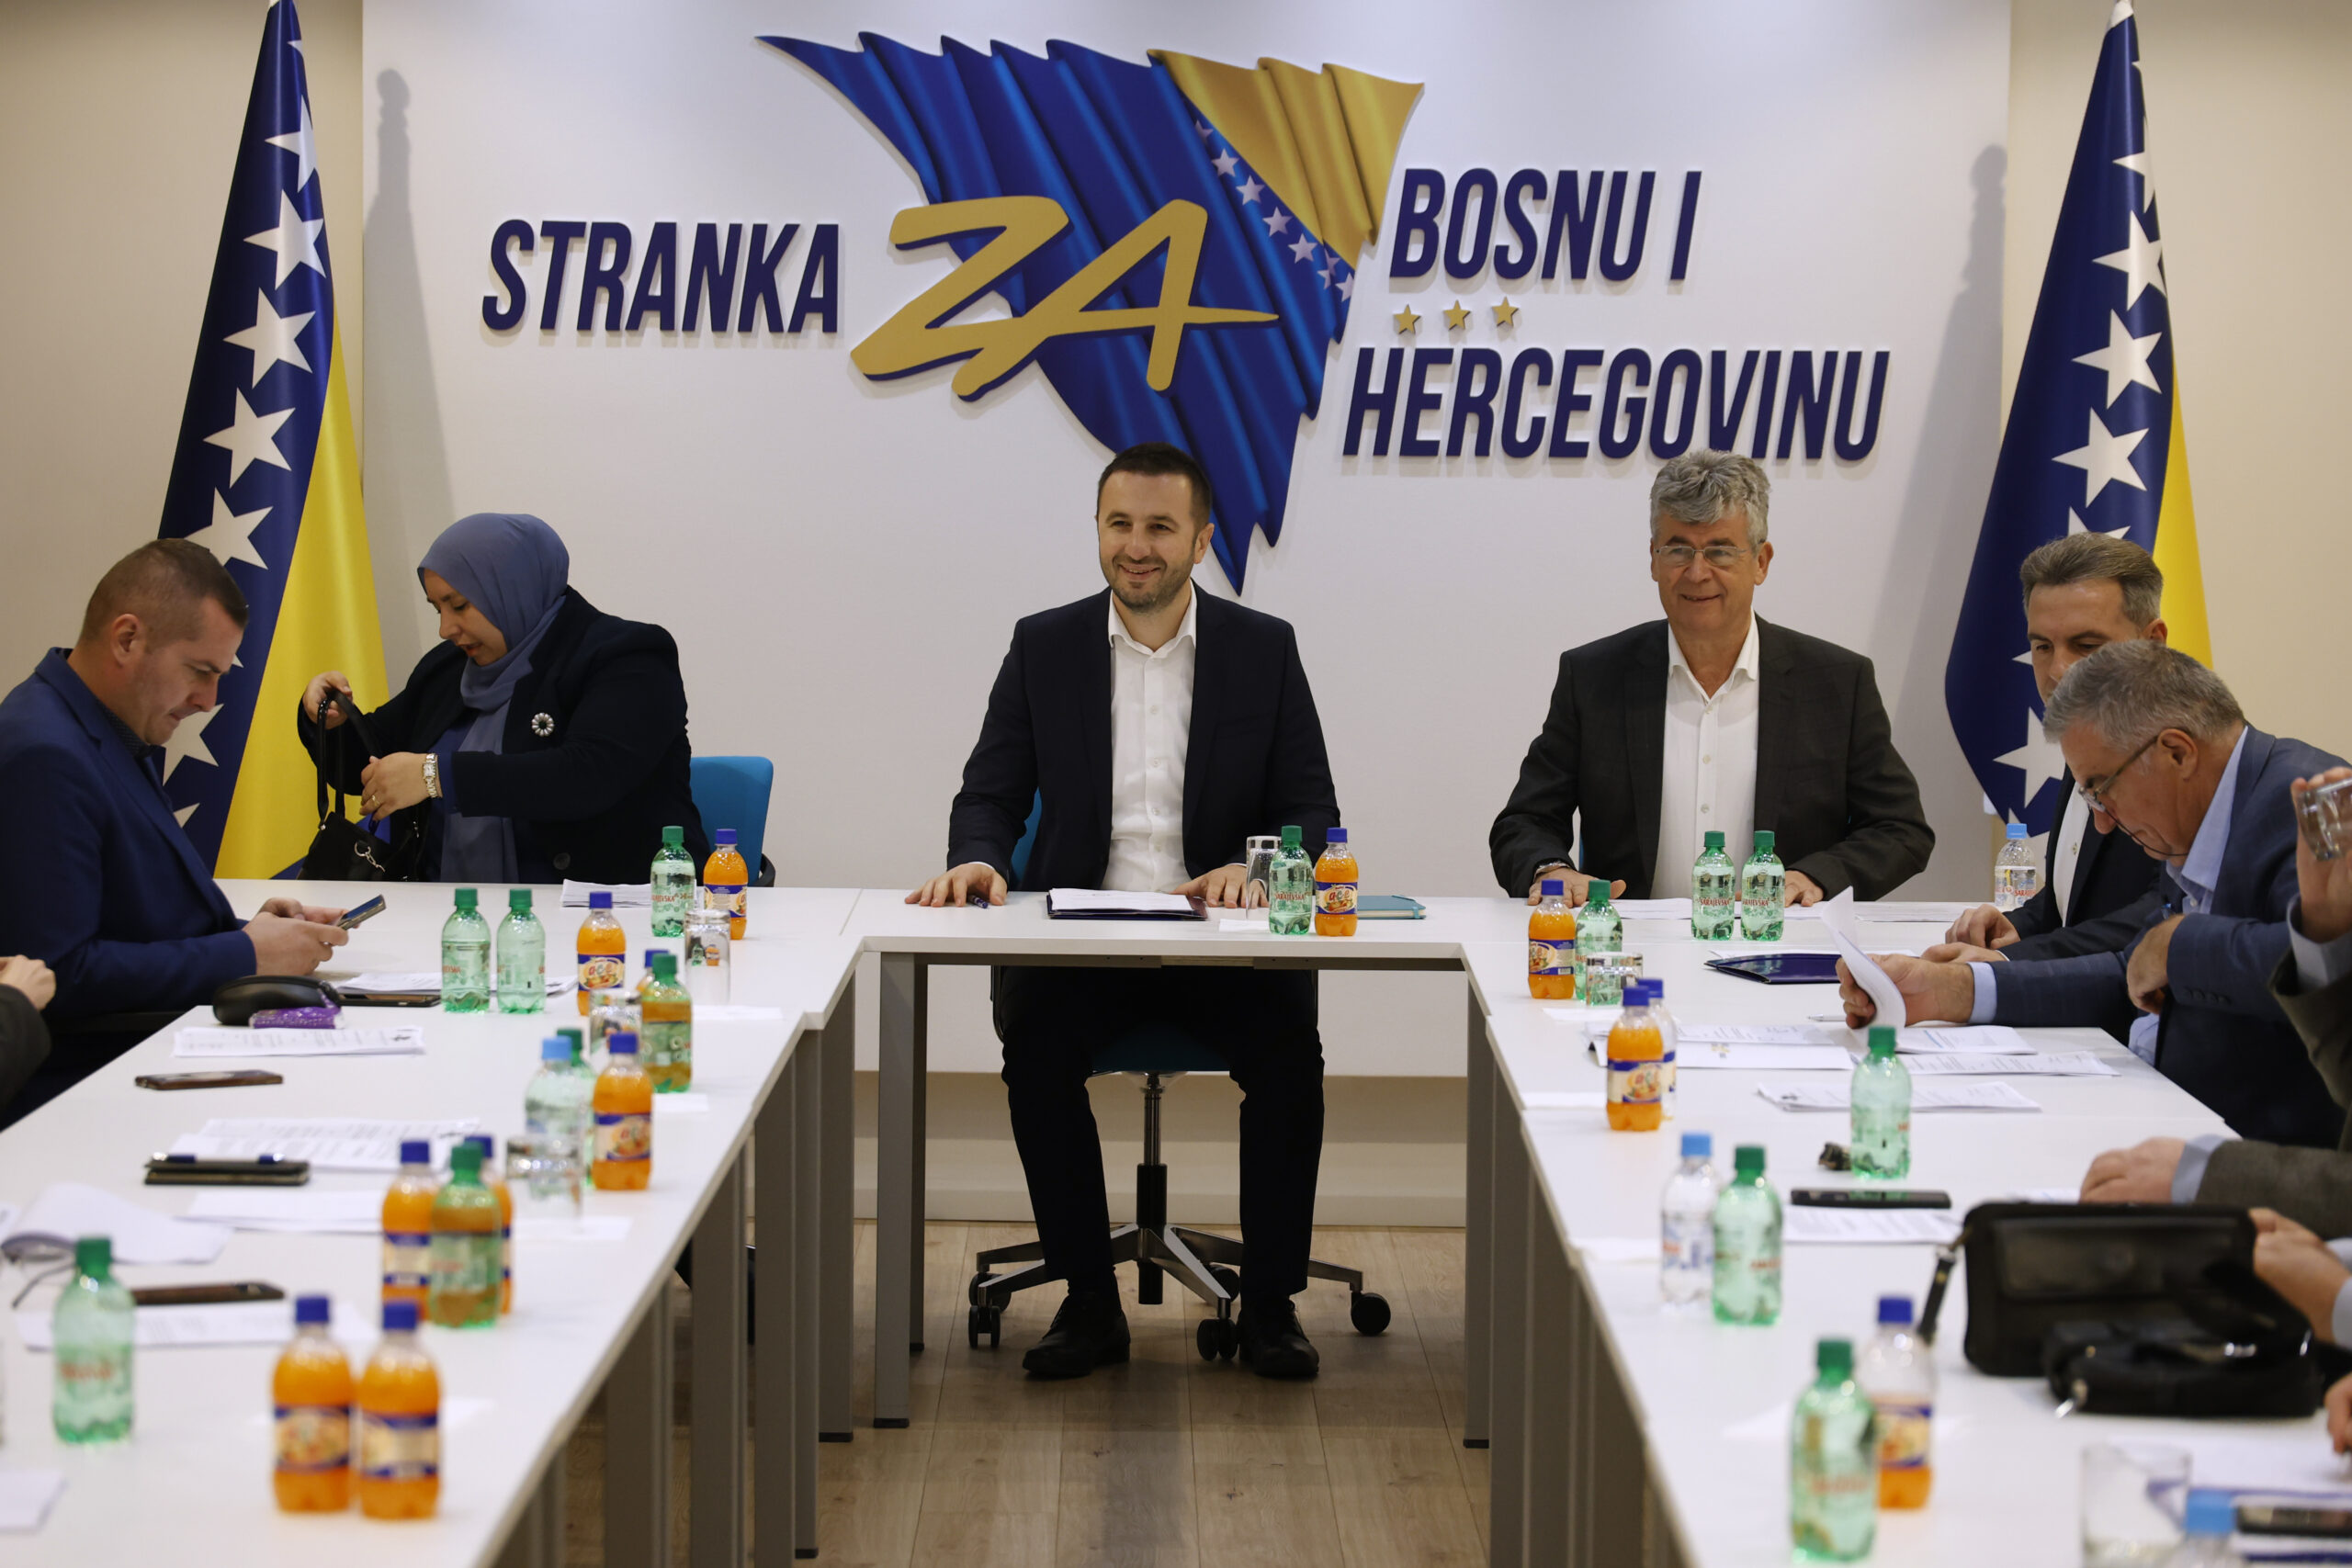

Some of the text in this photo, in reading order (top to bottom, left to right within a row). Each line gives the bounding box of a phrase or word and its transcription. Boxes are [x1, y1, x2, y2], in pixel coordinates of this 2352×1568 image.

[481, 219, 840, 332] STRANKA
[1389, 167, 1702, 280] BOSNU I
[850, 195, 1279, 401] ZA
[1342, 347, 1891, 459] HERCEGOVINU
